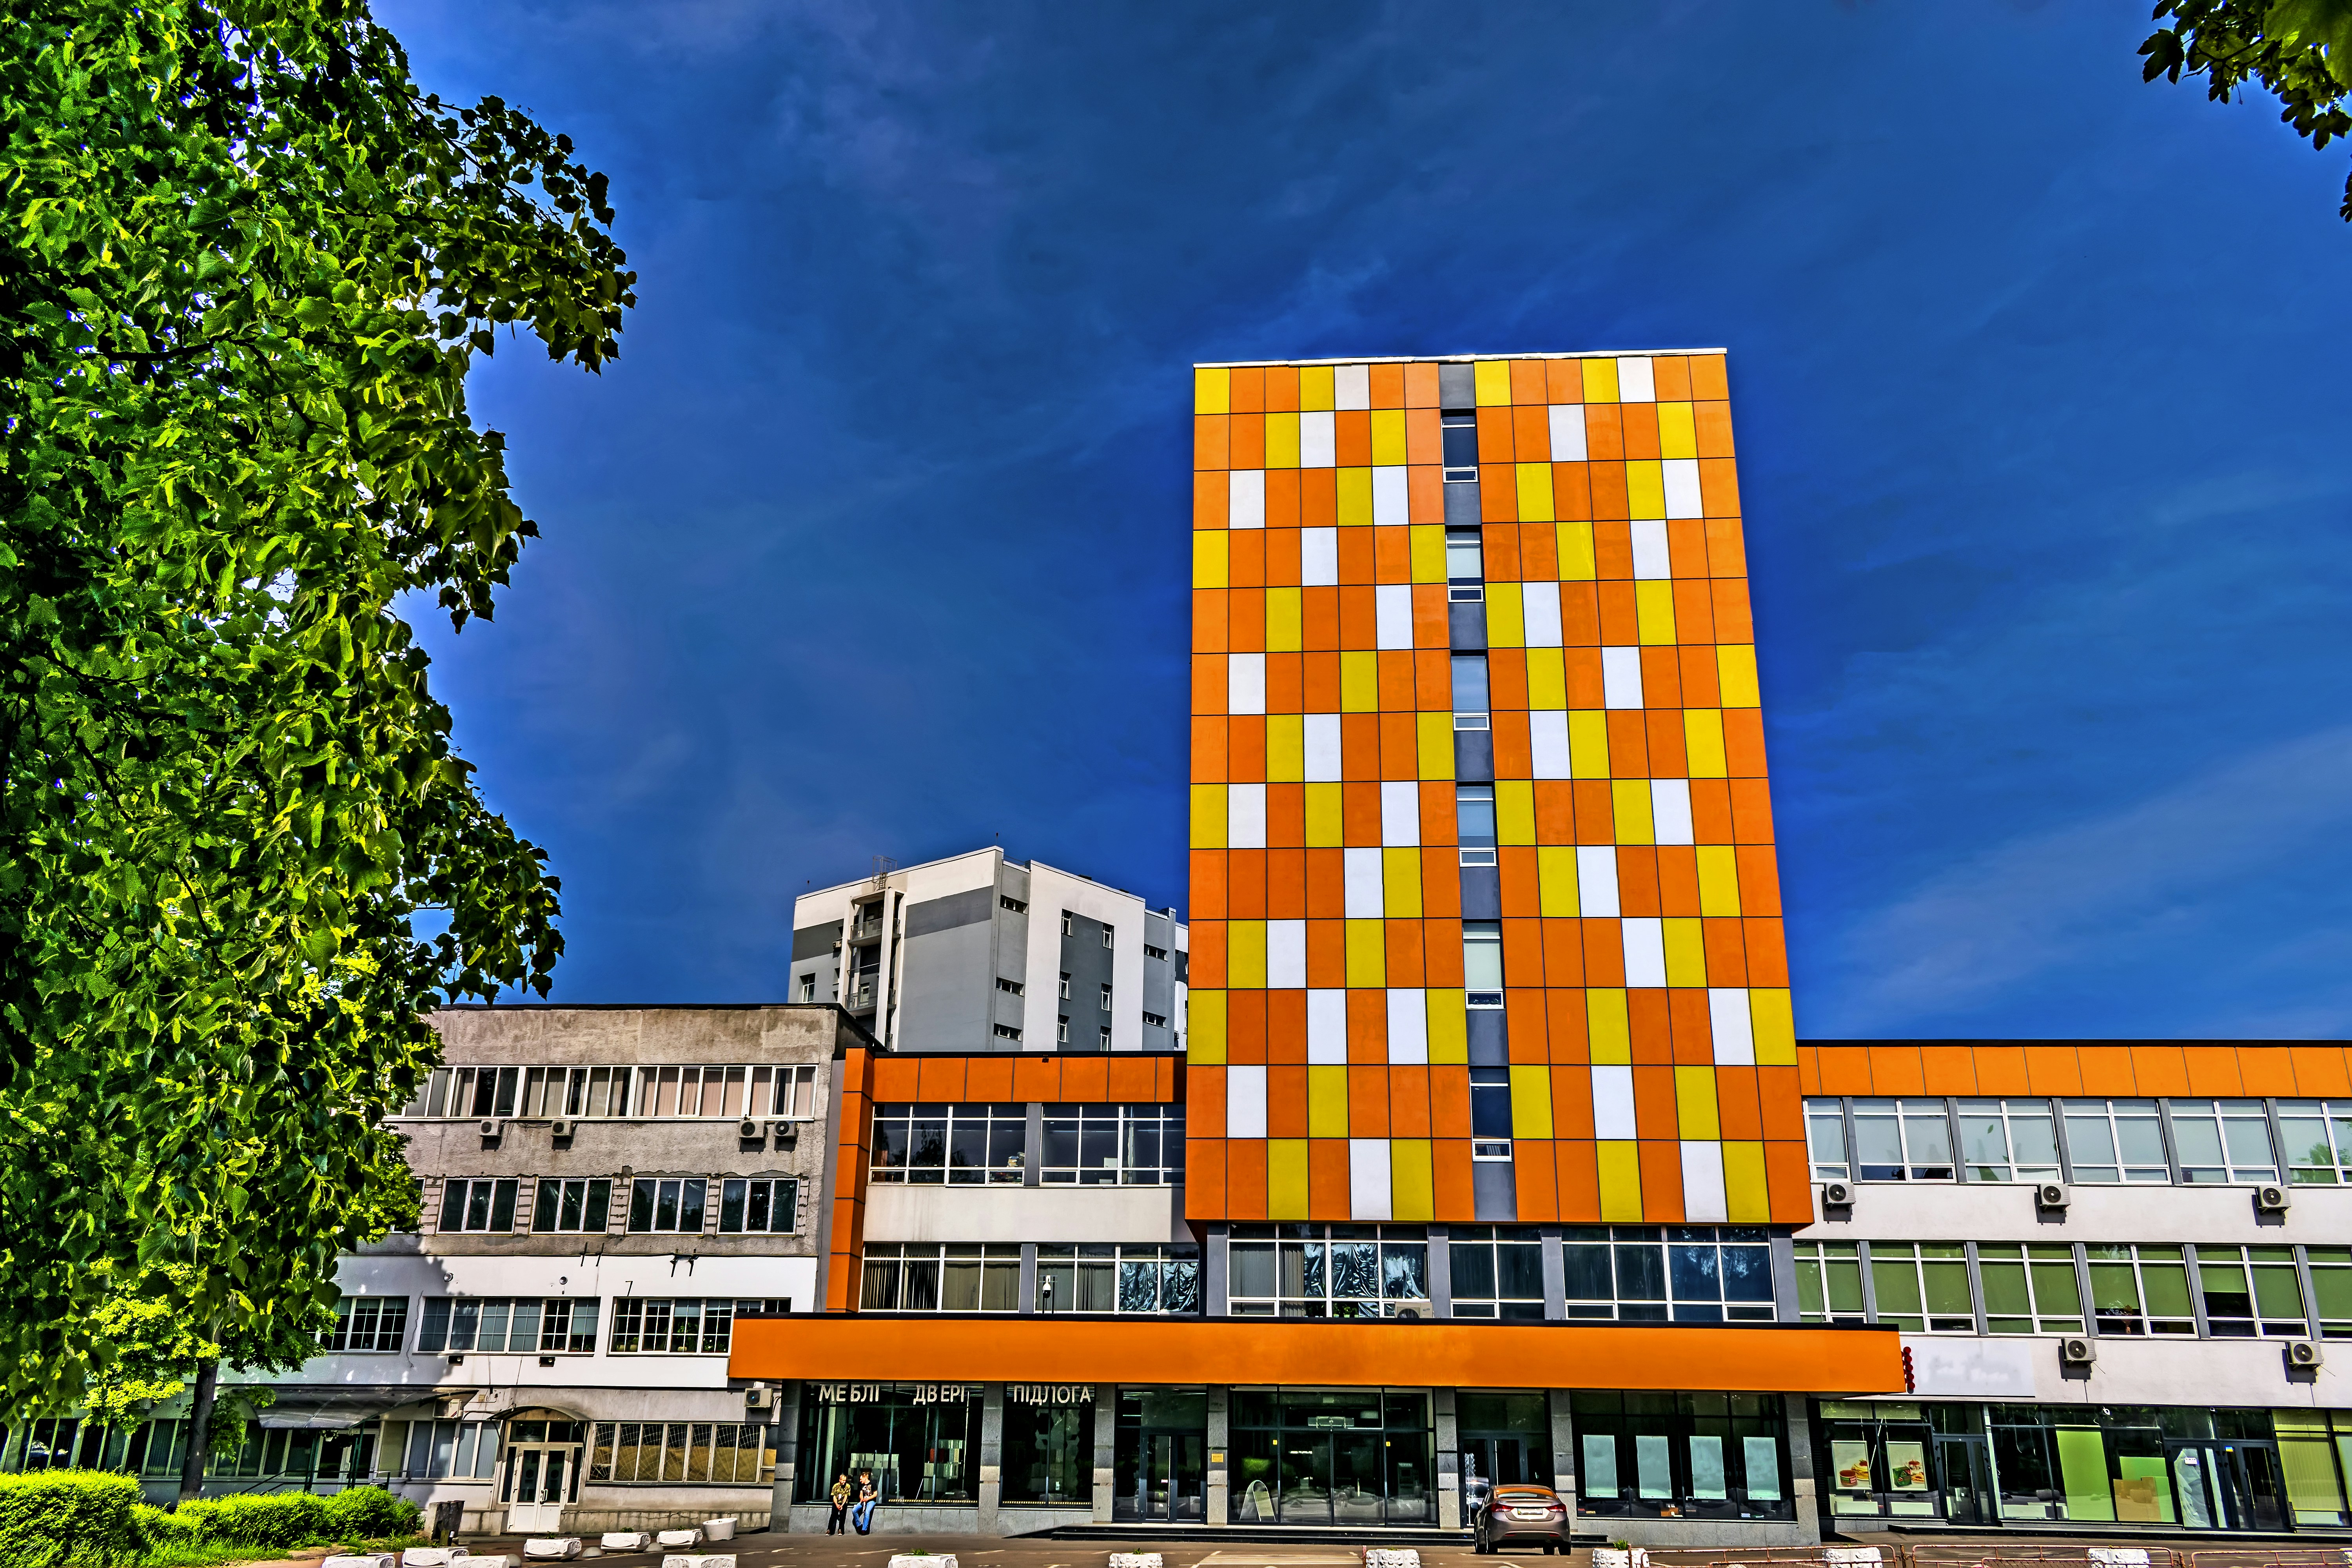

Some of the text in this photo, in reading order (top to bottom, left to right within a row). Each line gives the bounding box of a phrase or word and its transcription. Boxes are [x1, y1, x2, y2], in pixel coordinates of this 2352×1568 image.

[819, 1385, 965, 1405] МЕБЛІ ДВЕРІ
[1014, 1385, 1091, 1406] ПІДЛОГА
